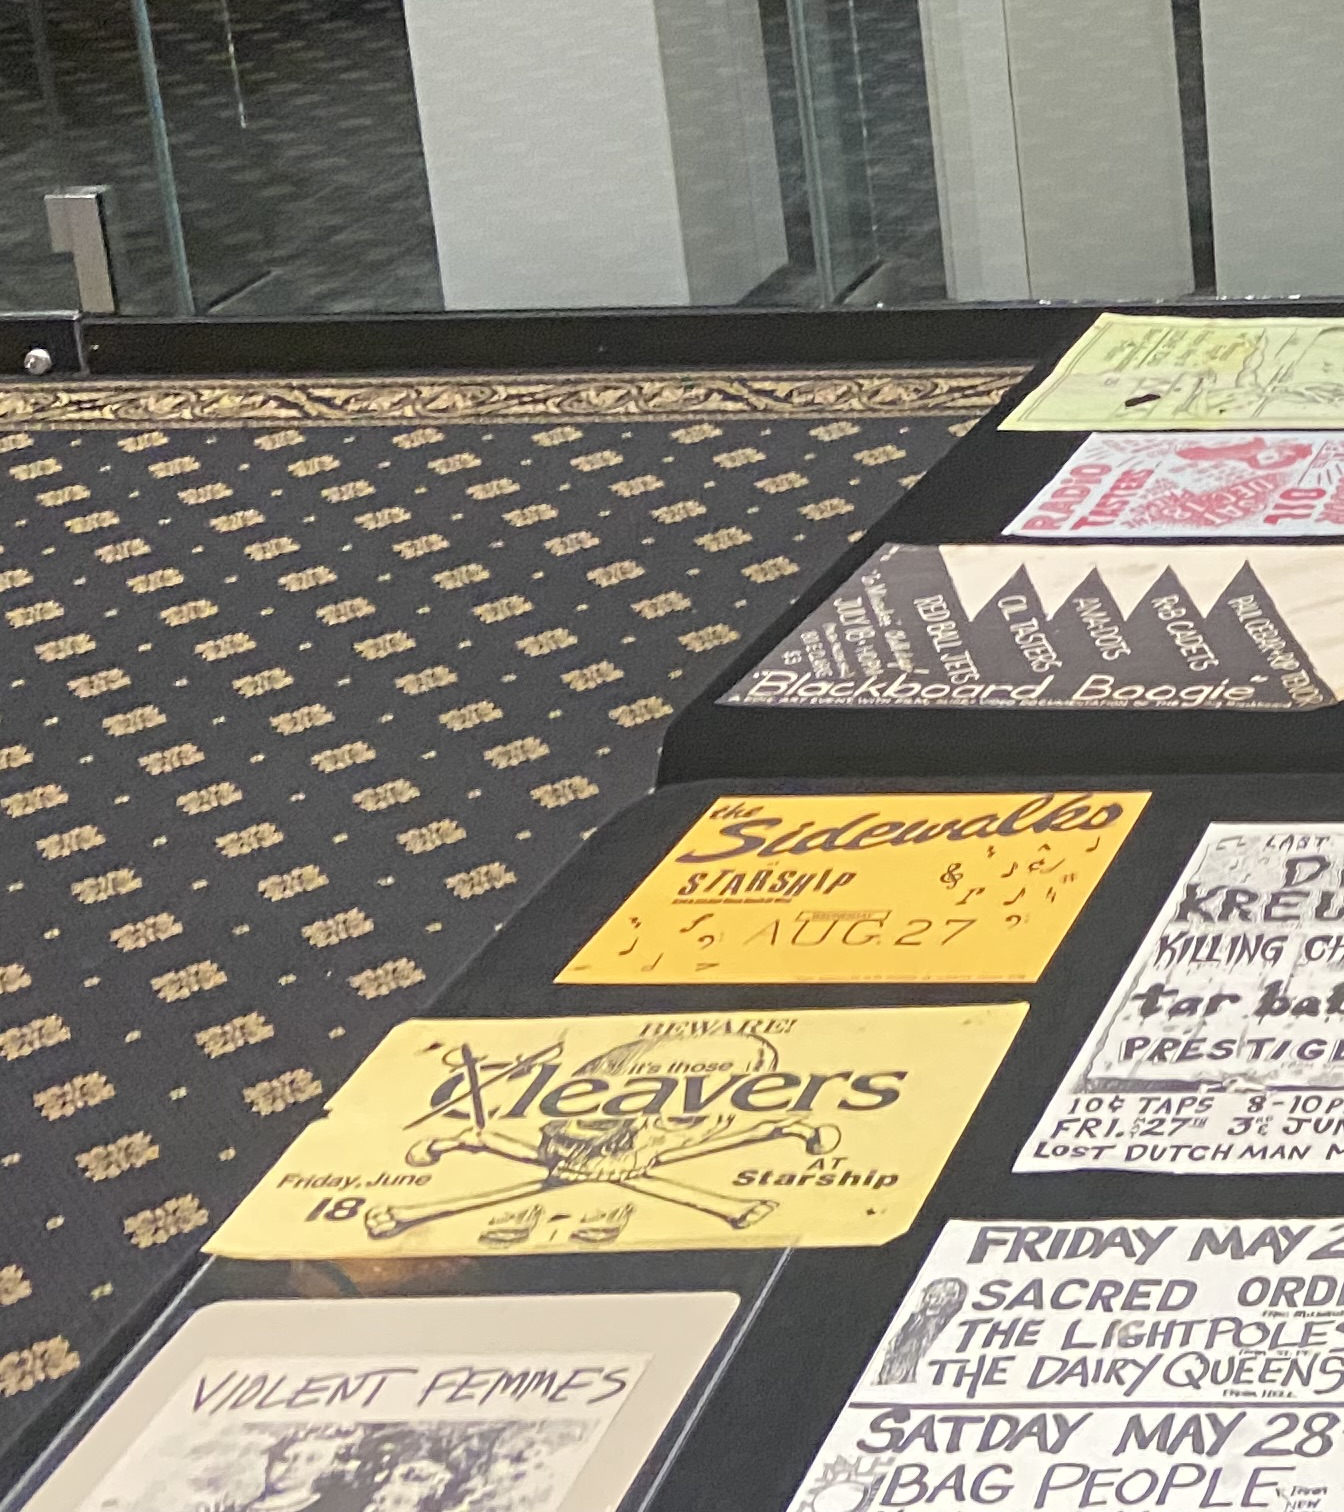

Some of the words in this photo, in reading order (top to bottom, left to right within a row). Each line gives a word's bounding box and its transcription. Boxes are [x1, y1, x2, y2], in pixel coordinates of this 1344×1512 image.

[710, 801, 764, 821] the
[675, 793, 1124, 864] Sidewalks
[1266, 834, 1330, 850] LAST
[679, 868, 857, 900] STARSHIP
[894, 918, 978, 947] 27
[1154, 933, 1290, 968] KILLING
[1131, 982, 1241, 1019] tar
[640, 1018, 798, 1039] BEWARE!
[667, 1058, 733, 1074] those
[1138, 1096, 1216, 1114] TAPS
[1050, 1117, 1124, 1139] FRI.
[806, 1157, 843, 1172] AT
[1032, 1141, 1116, 1160] LOST
[276, 1172, 361, 1191] Friday,
[363, 1171, 432, 1188] June
[730, 1168, 899, 1189] Starship
[304, 1197, 364, 1223] 18
[967, 1225, 1178, 1266] FRIDAY
[1188, 1224, 1317, 1264] MAY
[971, 1277, 1199, 1314] SACRED
[956, 1319, 1045, 1354] THE
[191, 1368, 419, 1416] VIOLENT
[417, 1366, 631, 1408] FEMMES
[929, 1355, 1017, 1400] THE
[1026, 1354, 1167, 1397] DAIRY
[856, 1409, 1094, 1456] SATDAY
[1114, 1412, 1248, 1456] MAY
[879, 1463, 1018, 1507] BAG
[1034, 1463, 1299, 1507] PEOPLE
